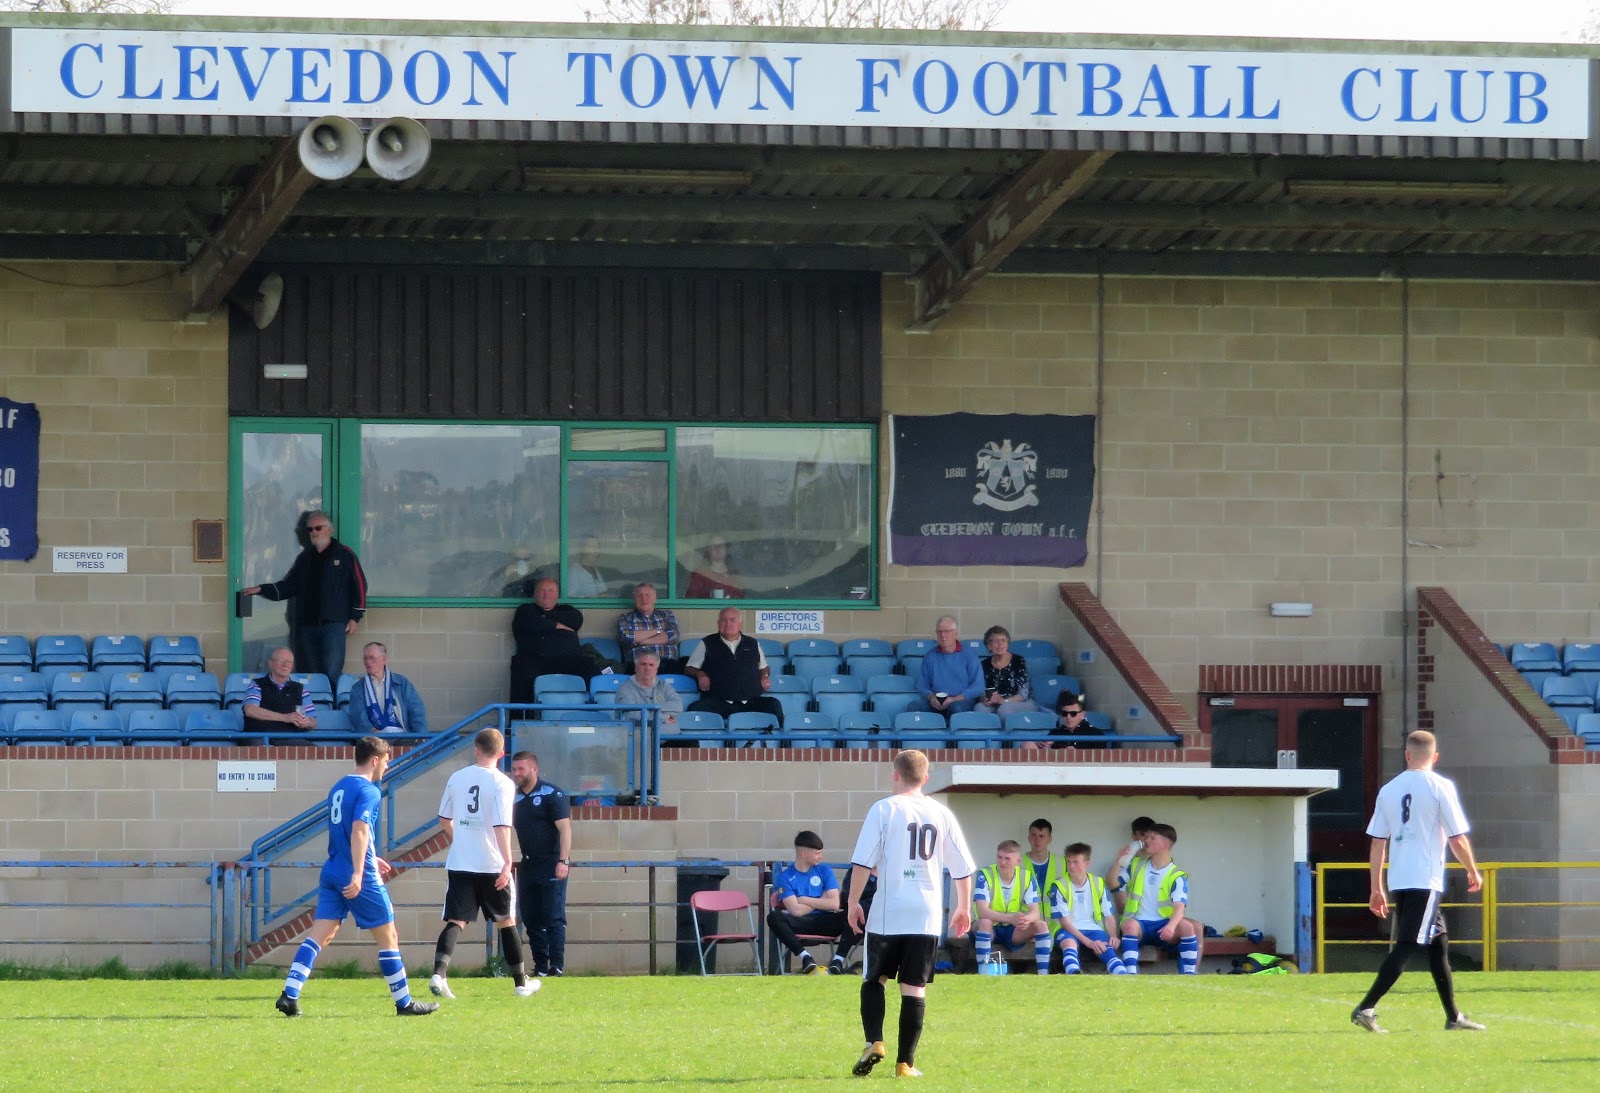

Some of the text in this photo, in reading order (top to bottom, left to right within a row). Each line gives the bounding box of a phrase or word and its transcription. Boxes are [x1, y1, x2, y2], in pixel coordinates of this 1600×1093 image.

[59, 43, 1549, 126] CLEVEDON TOWN FOOTBALL CLUB
[920, 522, 995, 537] CLEVEDON
[1001, 522, 1044, 537] TOWN
[57, 551, 124, 560] RESERVED FOR
[76, 561, 105, 569] PRESS
[761, 612, 818, 622] DIRECTORS
[758, 622, 820, 632] & OFFICIALS
[218, 772, 275, 781] NO ENTRY TO STAND
[467, 784, 480, 814] 3
[330, 789, 345, 825] 8
[1401, 793, 1412, 825] 8
[907, 822, 938, 861] 10
